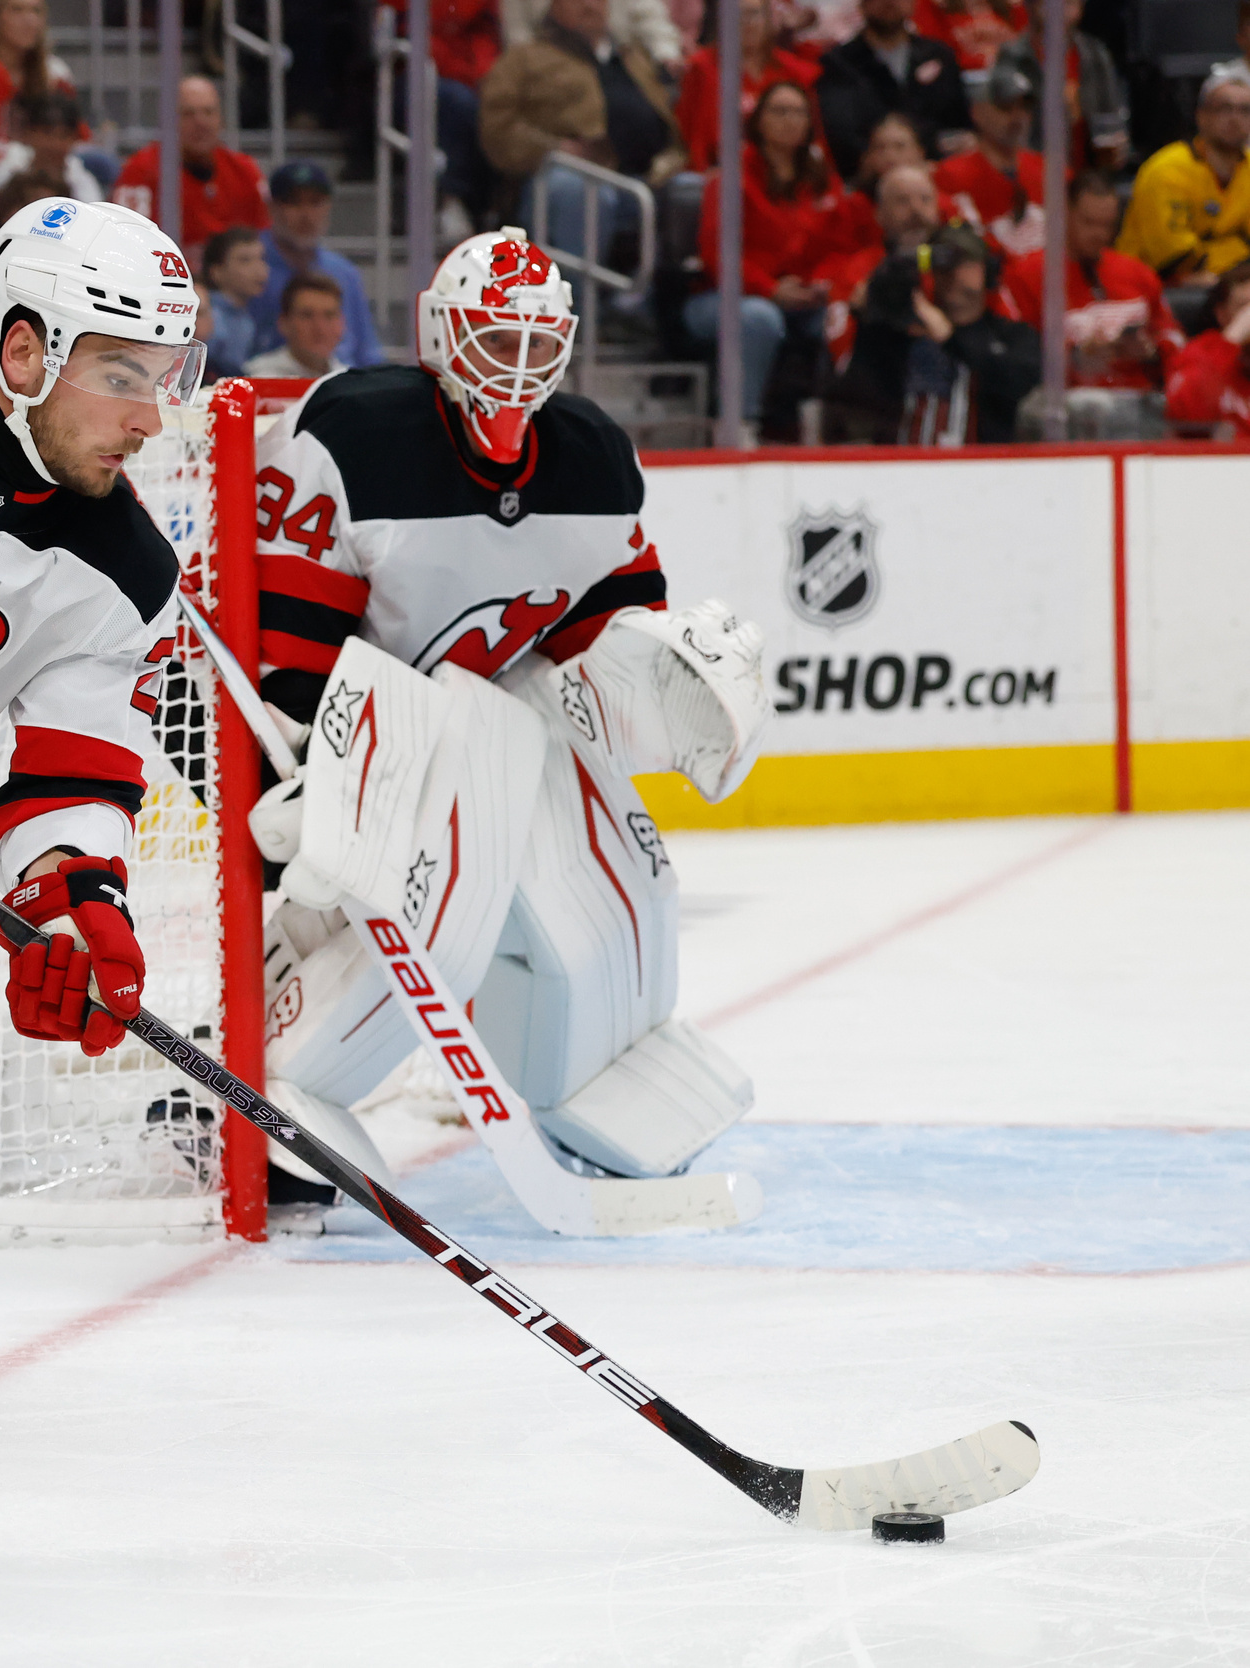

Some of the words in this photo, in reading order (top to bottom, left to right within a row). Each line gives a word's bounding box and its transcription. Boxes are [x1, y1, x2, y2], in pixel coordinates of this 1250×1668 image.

[30, 226, 64, 241] Prudential
[151, 250, 189, 279] 28
[156, 301, 194, 315] CCM
[256, 465, 337, 562] 34
[12, 882, 41, 908] 28
[113, 983, 138, 997] TRUE
[420, 1223, 659, 1411] TRUE
